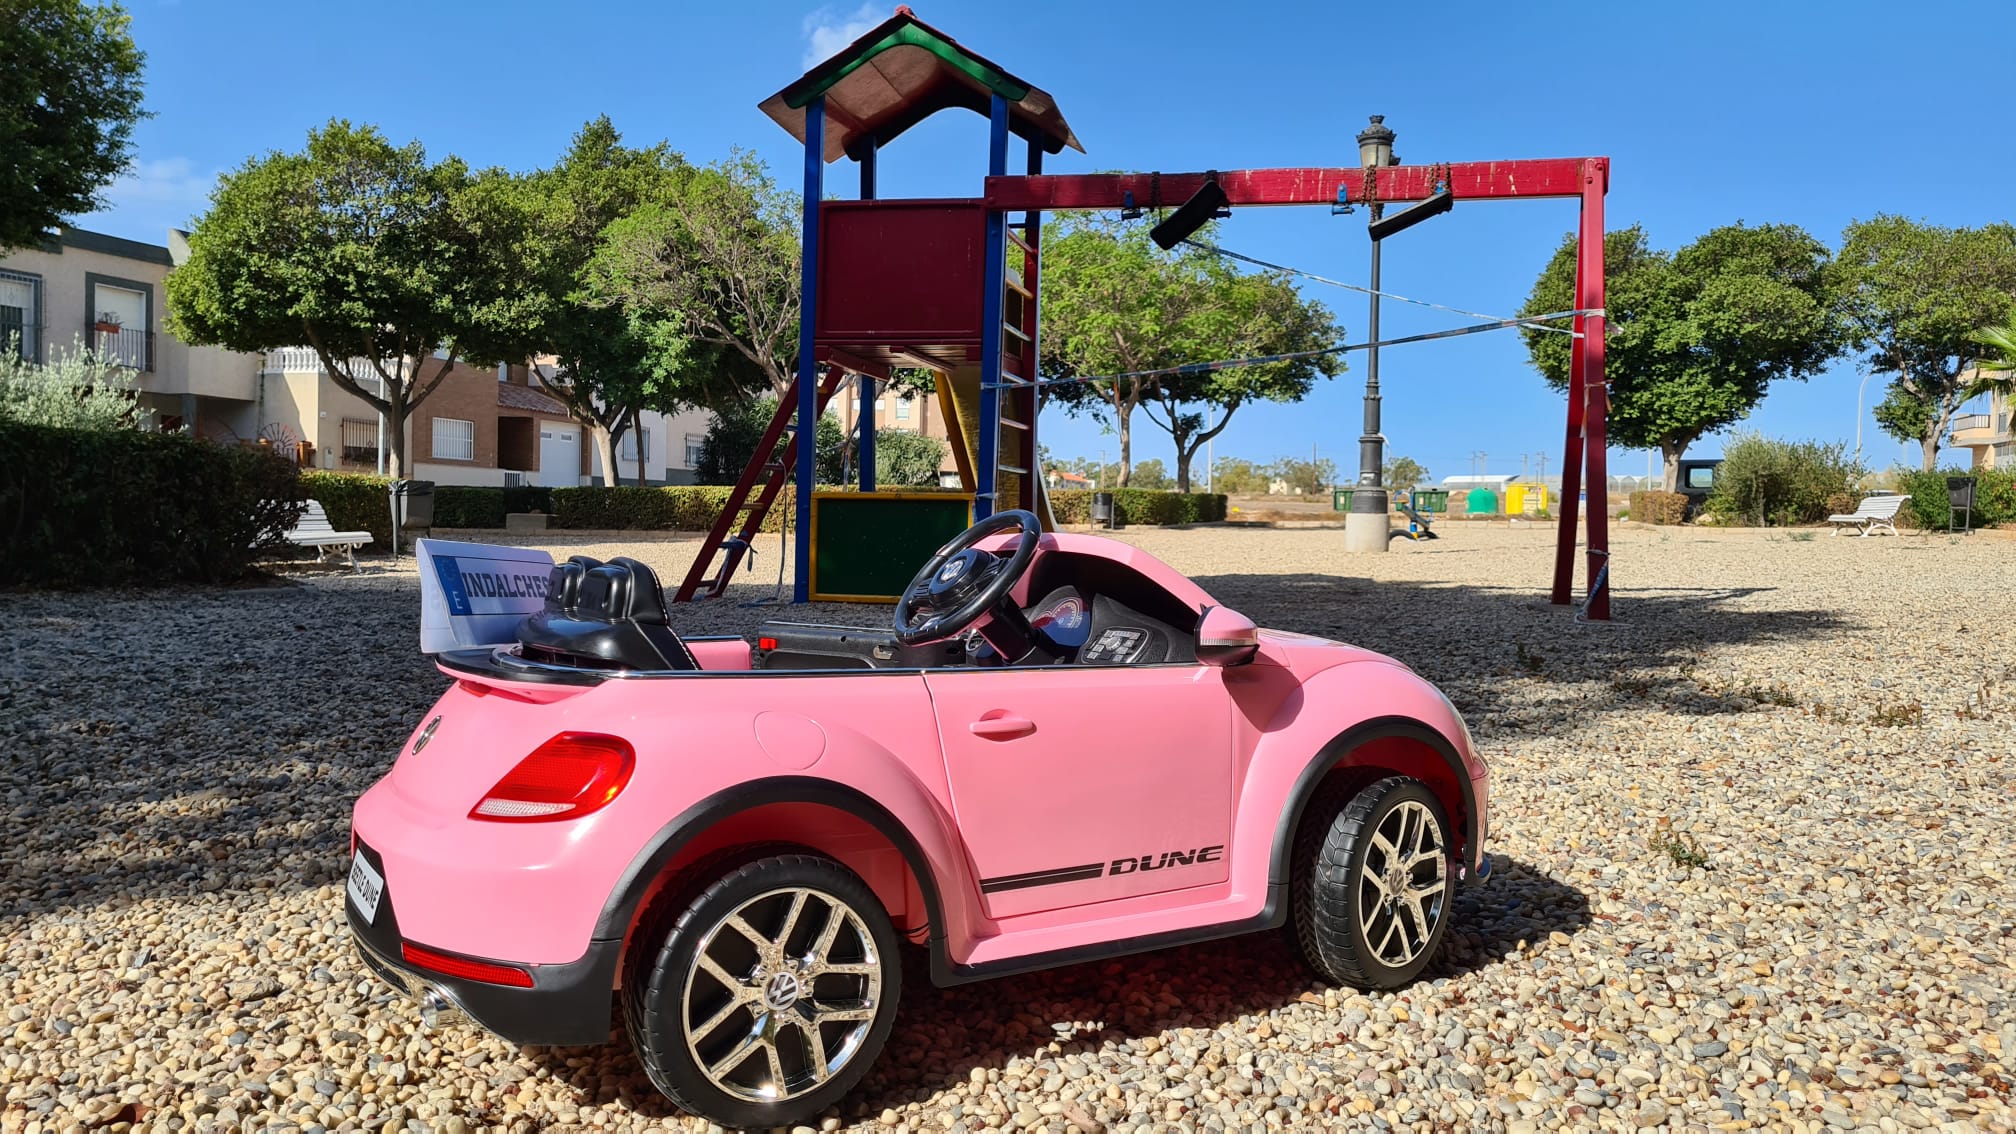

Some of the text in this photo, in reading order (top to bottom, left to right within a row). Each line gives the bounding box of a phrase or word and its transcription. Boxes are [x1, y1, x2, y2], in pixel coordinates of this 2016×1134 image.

[452, 591, 463, 609] E
[1109, 845, 1224, 875] DUNE
[363, 880, 378, 908] DUNE
